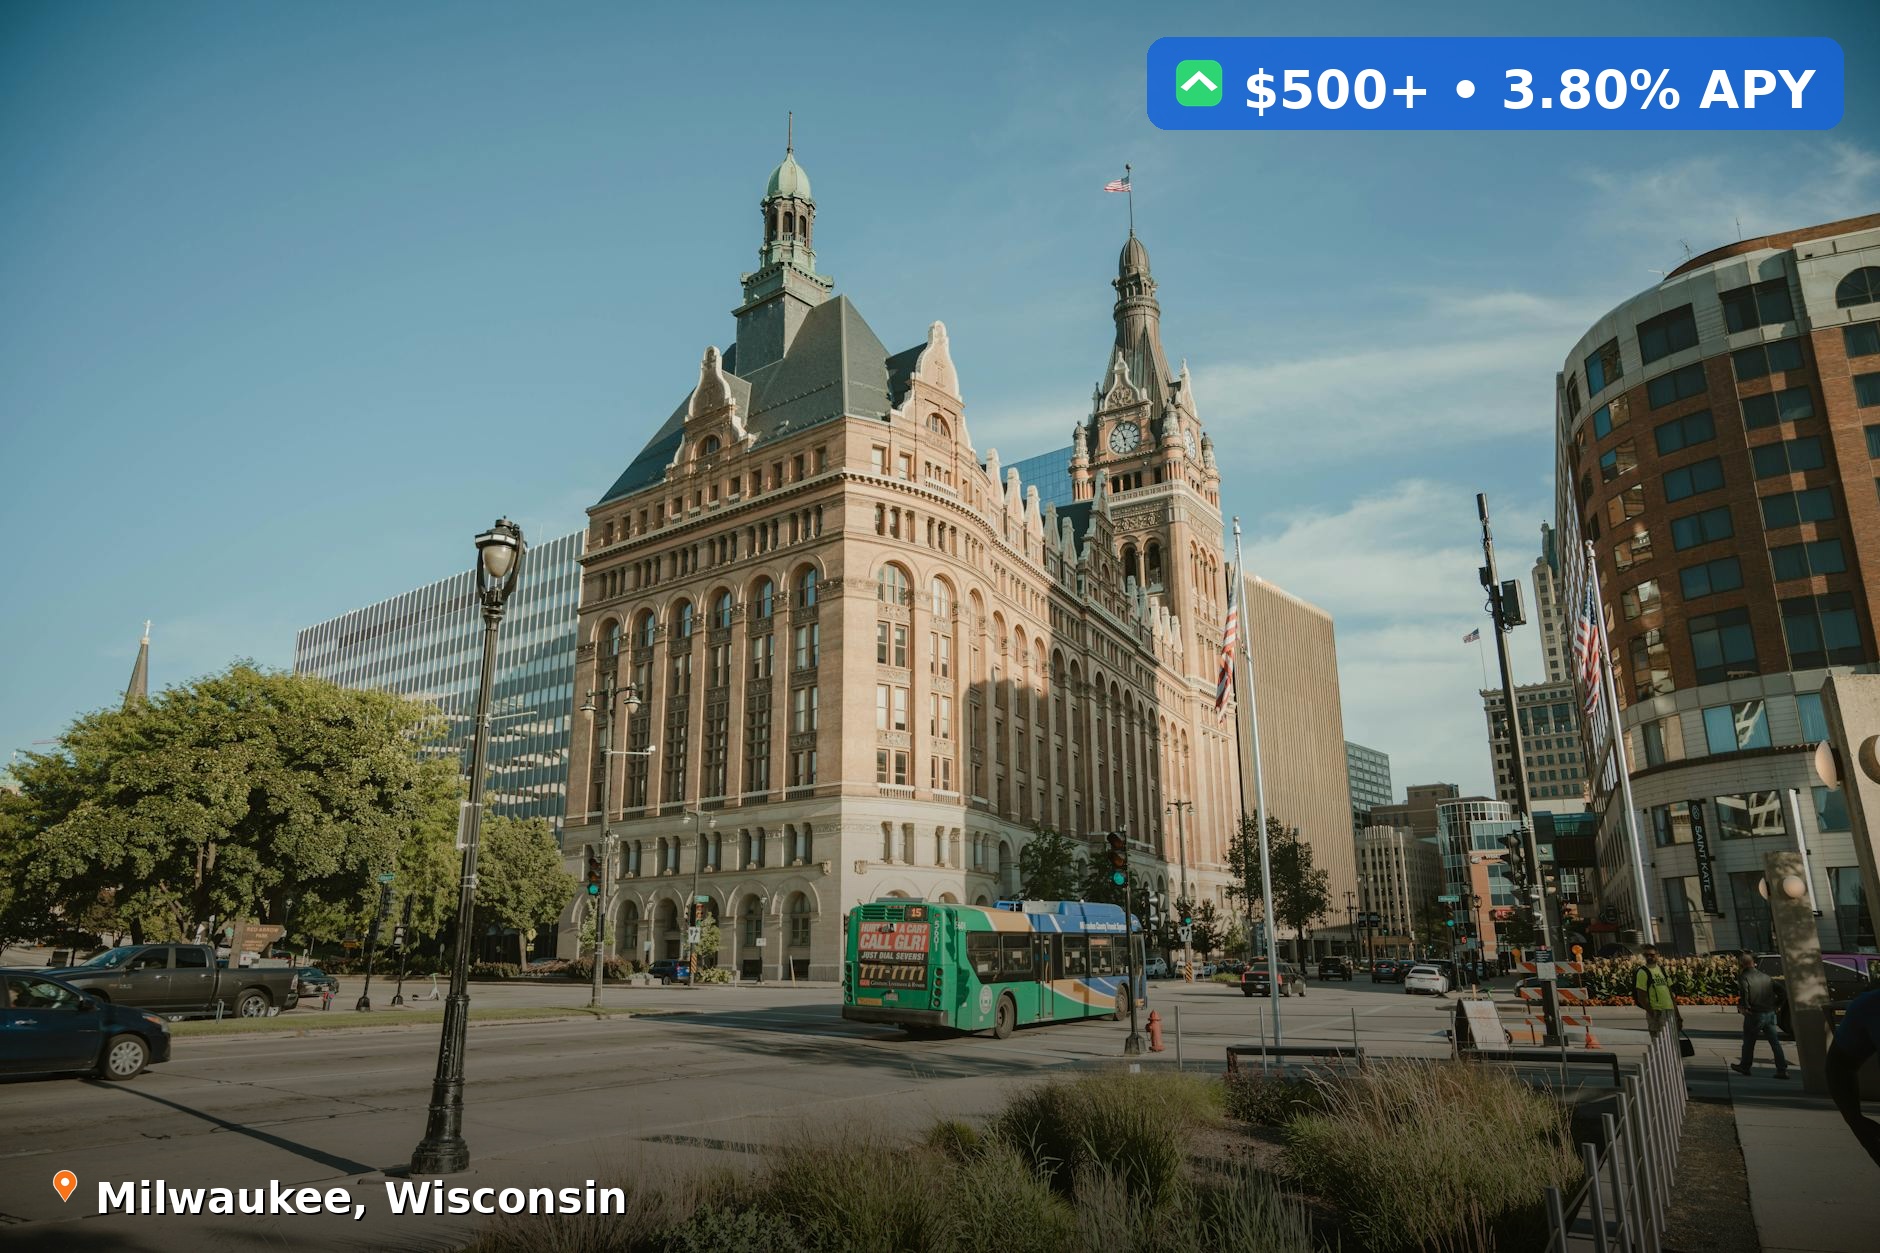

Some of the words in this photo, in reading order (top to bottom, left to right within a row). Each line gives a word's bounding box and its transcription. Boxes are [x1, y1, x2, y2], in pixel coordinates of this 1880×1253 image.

[1694, 825, 1707, 859] SAINT
[1700, 862, 1711, 892] KATE
[911, 908, 922, 917] 15
[907, 924, 927, 934] CAR?
[860, 933, 891, 950] CALL
[895, 934, 927, 951] GLR!
[861, 951, 878, 959] JUST
[879, 952, 894, 960] DIAL
[895, 952, 925, 960] SEVENS!
[860, 963, 925, 981] 777-7777
